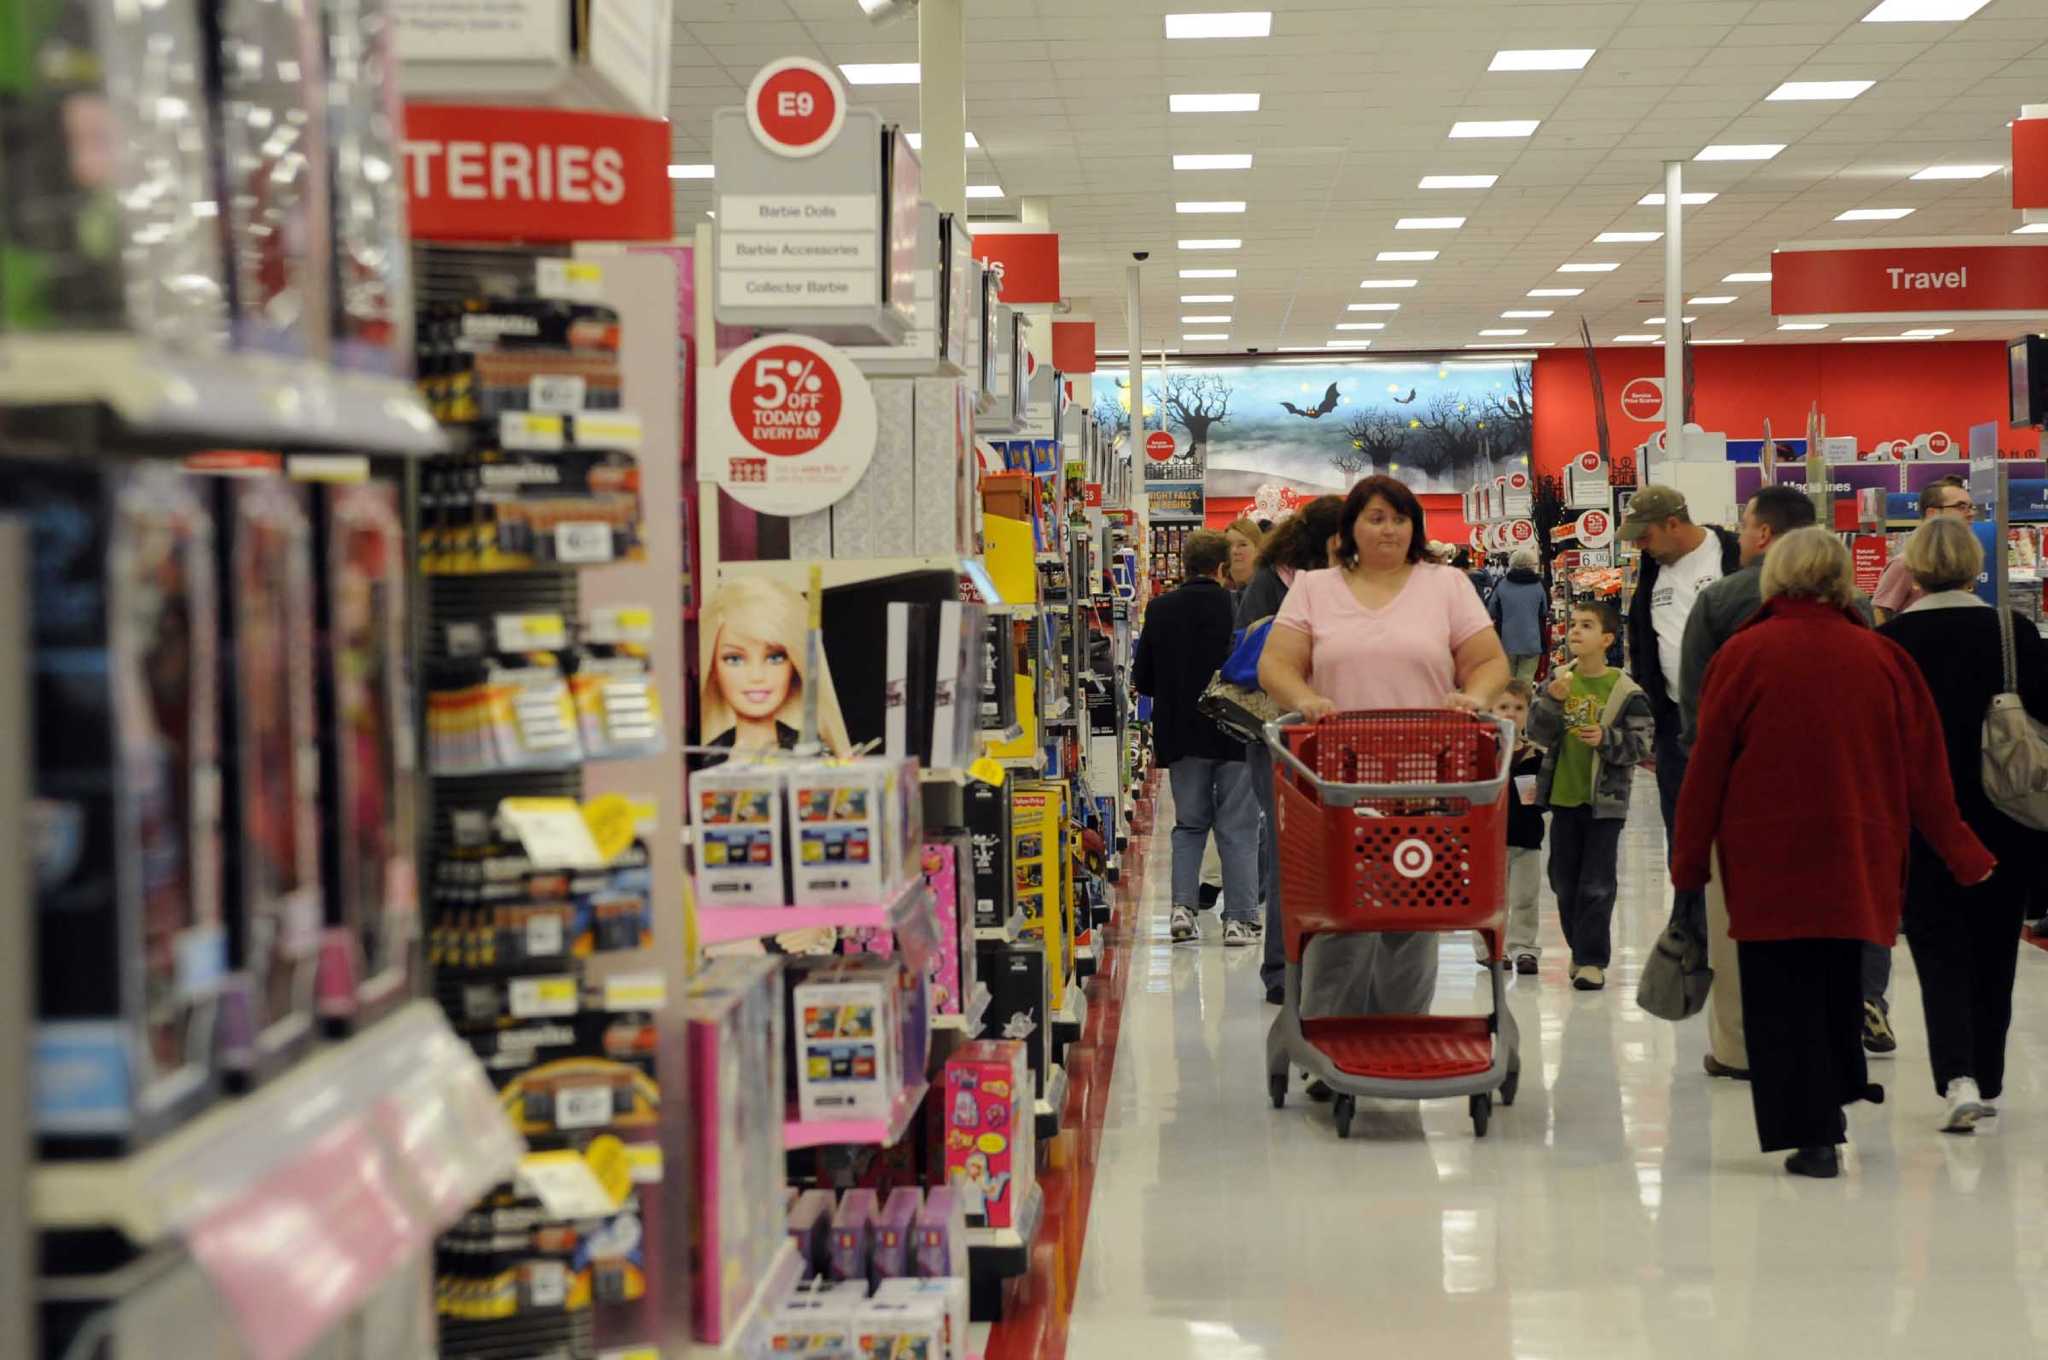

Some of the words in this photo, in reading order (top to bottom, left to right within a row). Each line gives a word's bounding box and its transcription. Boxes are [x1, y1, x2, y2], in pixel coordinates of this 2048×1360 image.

[777, 91, 815, 117] E9
[759, 205, 801, 219] Barbie
[804, 205, 837, 219] Dolls
[736, 243, 778, 256] Barbie
[781, 243, 859, 256] Accessories
[1886, 266, 1967, 289] Travel
[745, 281, 802, 295] Collector
[806, 281, 849, 295] Barbie
[753, 358, 823, 410] 5%
[787, 393, 823, 409] OFF
[752, 411, 804, 425] TODAY
[752, 427, 793, 440] EVERY
[795, 427, 821, 440] DAY
